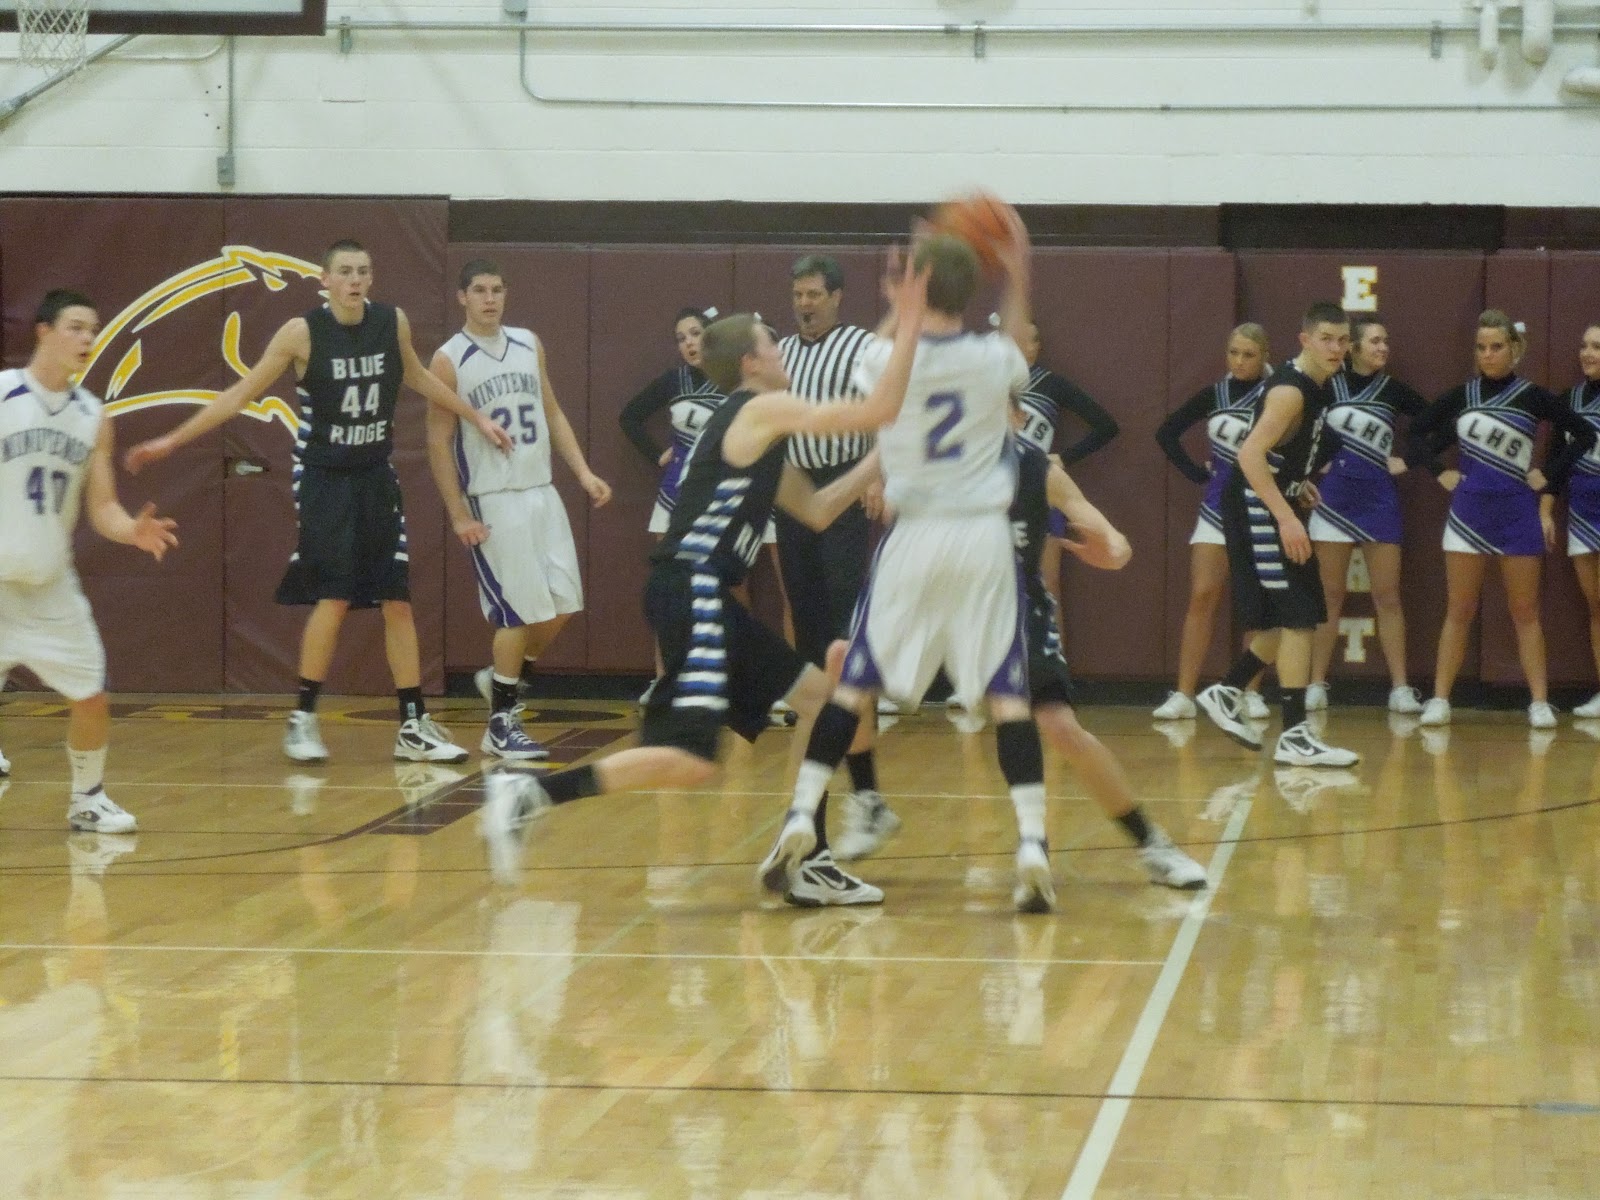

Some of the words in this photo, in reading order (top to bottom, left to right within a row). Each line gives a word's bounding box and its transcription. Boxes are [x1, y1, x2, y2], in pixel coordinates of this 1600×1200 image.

[331, 353, 385, 380] BLUE
[341, 383, 380, 418] 44
[329, 420, 388, 446] RIDGE
[490, 404, 538, 445] 25
[926, 391, 967, 462] 2
[1341, 411, 1393, 450] LHS
[1467, 419, 1523, 458] LHS
